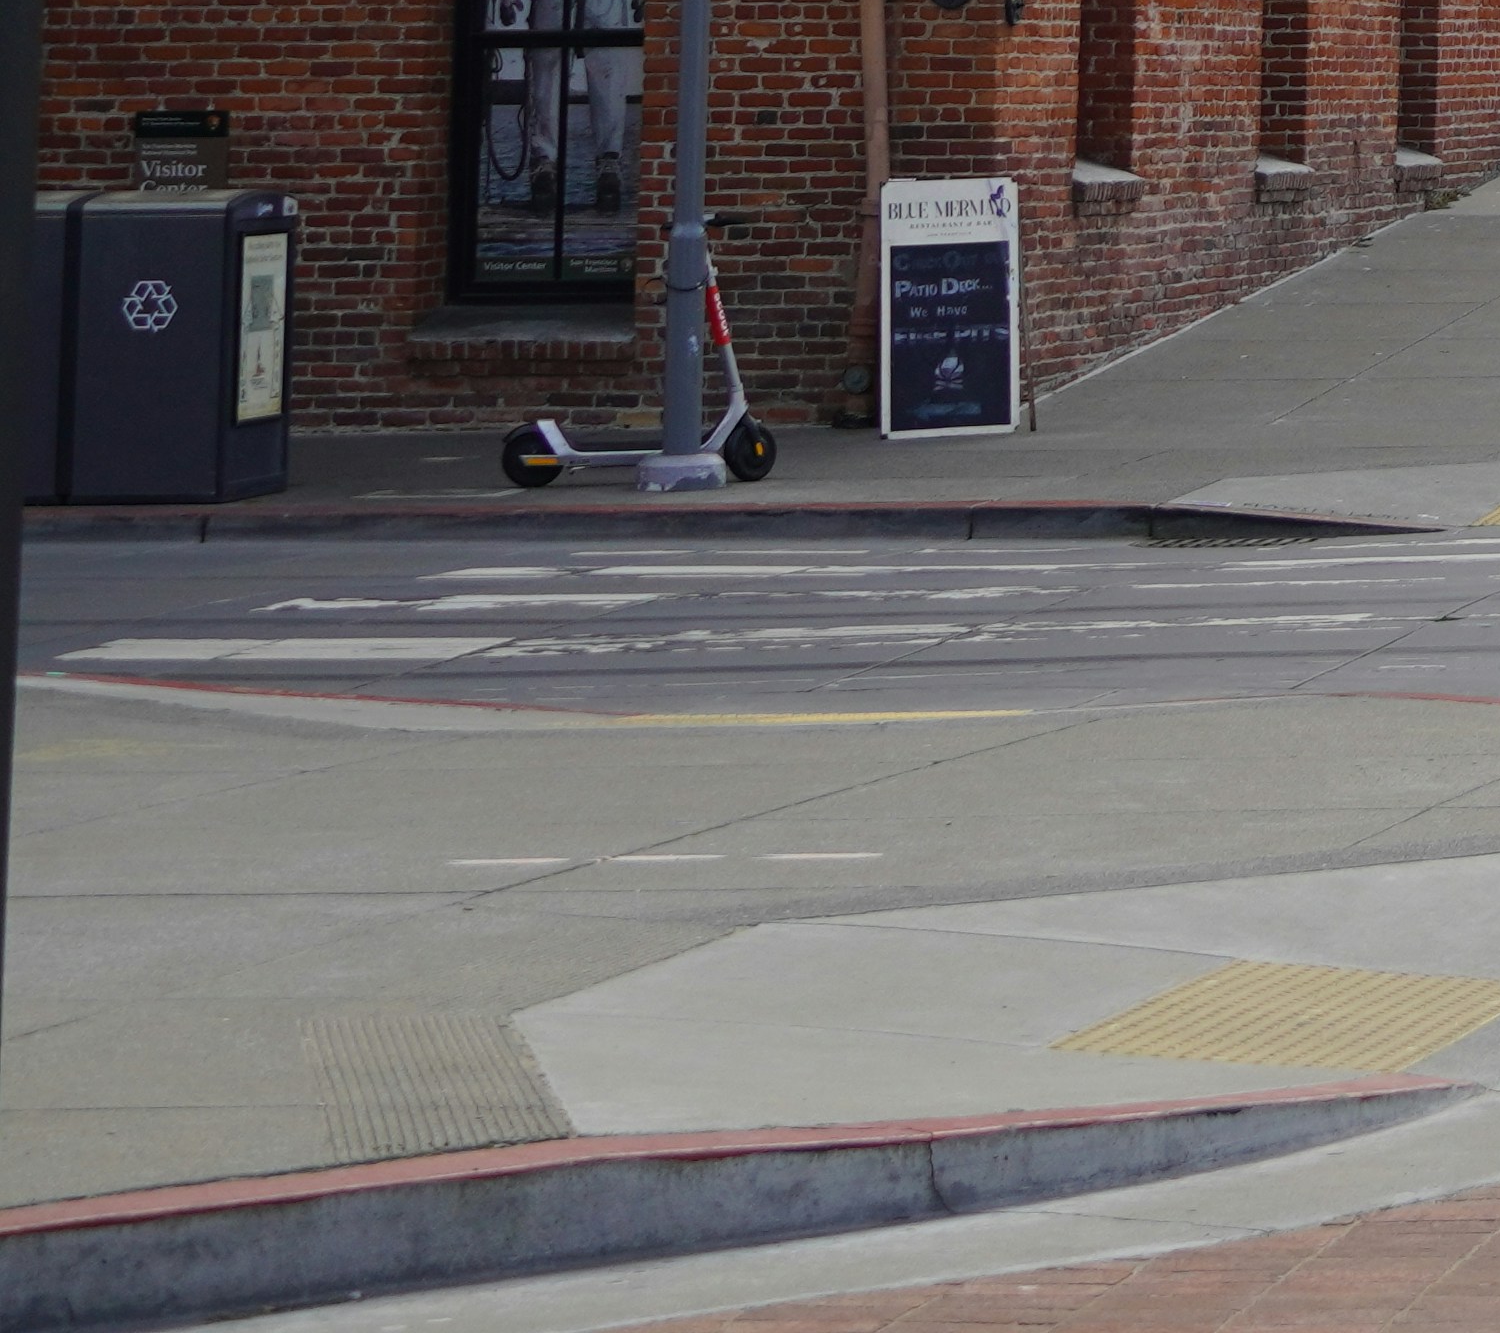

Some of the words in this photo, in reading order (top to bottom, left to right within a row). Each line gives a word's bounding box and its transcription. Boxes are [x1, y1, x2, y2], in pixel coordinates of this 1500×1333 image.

[140, 159, 208, 178] Visitor
[888, 201, 929, 220] BLUE
[515, 260, 547, 271] Center
